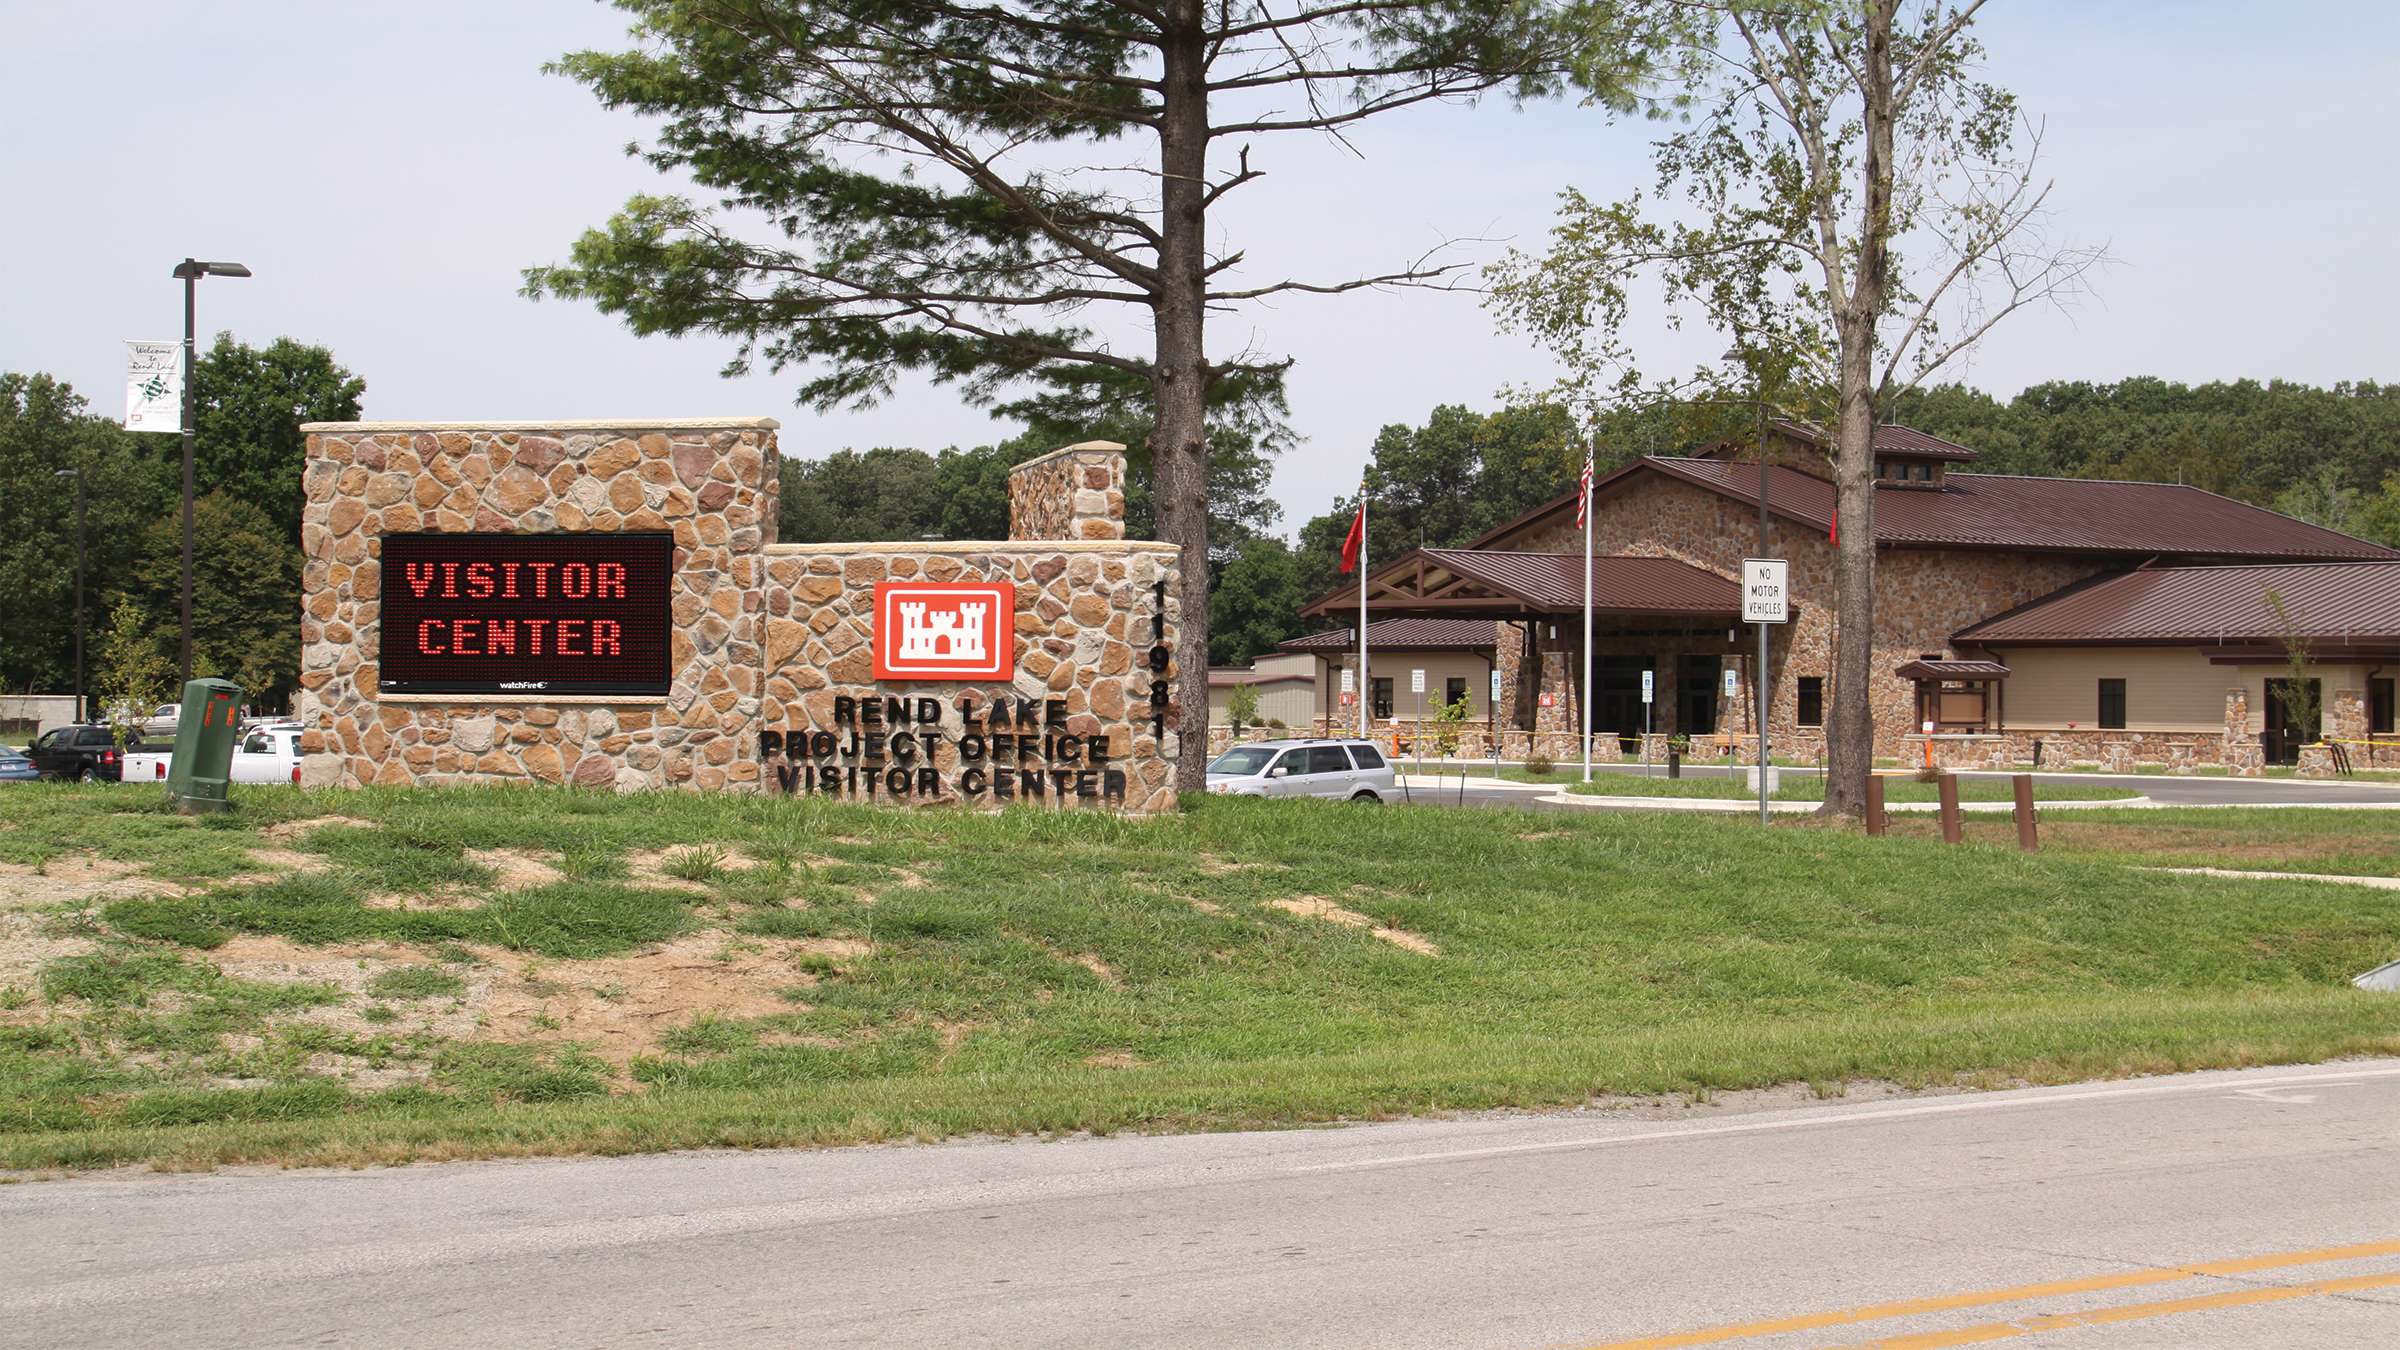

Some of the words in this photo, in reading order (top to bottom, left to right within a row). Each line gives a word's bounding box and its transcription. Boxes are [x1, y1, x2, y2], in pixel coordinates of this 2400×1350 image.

[135, 345, 171, 354] Welcome
[132, 361, 154, 369] Rend
[406, 563, 626, 598] VISITOR
[1759, 568, 1770, 580] NO
[1751, 585, 1779, 597] MOTOR
[1749, 602, 1781, 615] VEHICLES
[418, 620, 621, 655] CENTER
[834, 696, 942, 724] REND
[962, 698, 1068, 726] LAKE
[761, 730, 942, 759] PROJECT
[959, 734, 1110, 762] OFFICE
[777, 765, 941, 796] VISITOR
[961, 767, 1126, 799] CENTER
